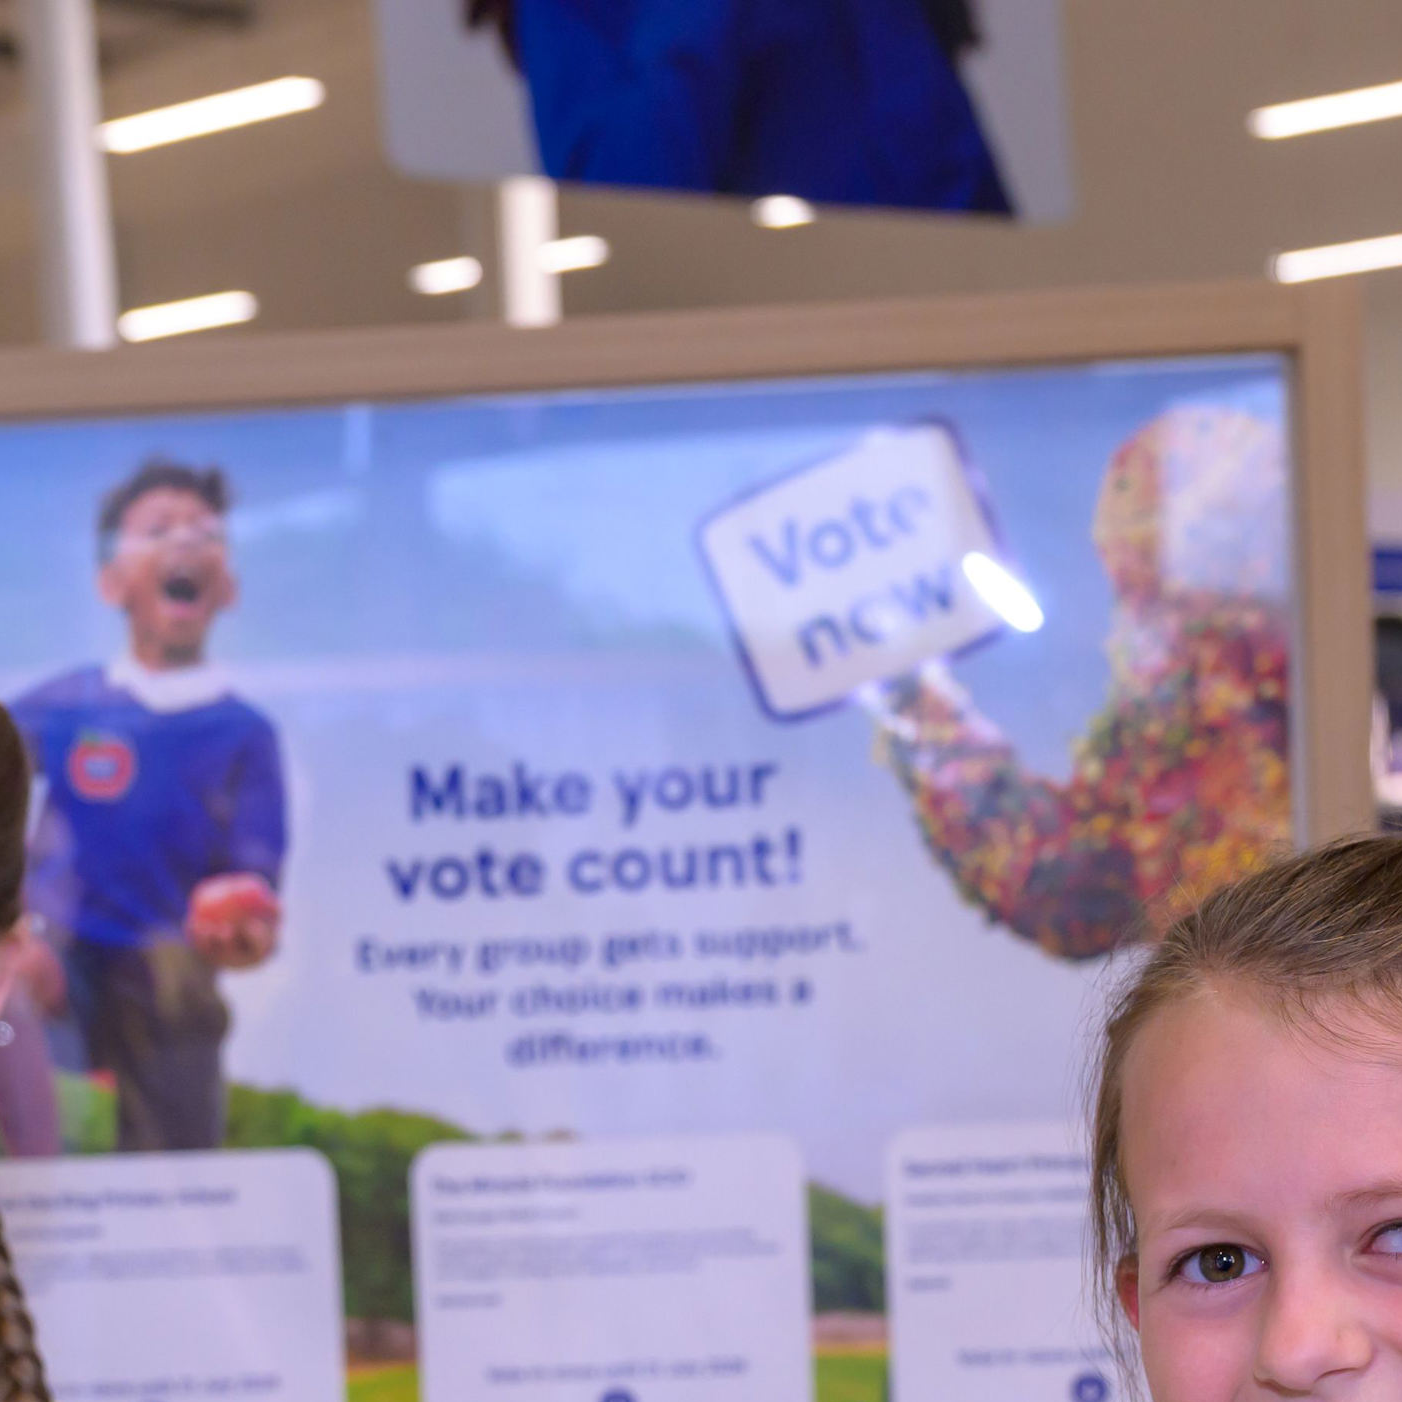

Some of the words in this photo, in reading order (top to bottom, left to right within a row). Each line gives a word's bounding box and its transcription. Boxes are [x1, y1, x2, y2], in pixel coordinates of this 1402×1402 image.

[409, 763, 590, 821] Make
[610, 760, 778, 828] your
[385, 846, 546, 903] vote
[564, 827, 803, 896] count!
[355, 938, 466, 977] Every
[475, 936, 591, 974] group
[601, 931, 682, 970] gets
[694, 920, 864, 967] support.
[412, 988, 498, 1021] Your
[509, 984, 644, 1016] choice
[655, 980, 778, 1010] makes
[791, 979, 812, 1004] a
[506, 1031, 721, 1069] difference.
